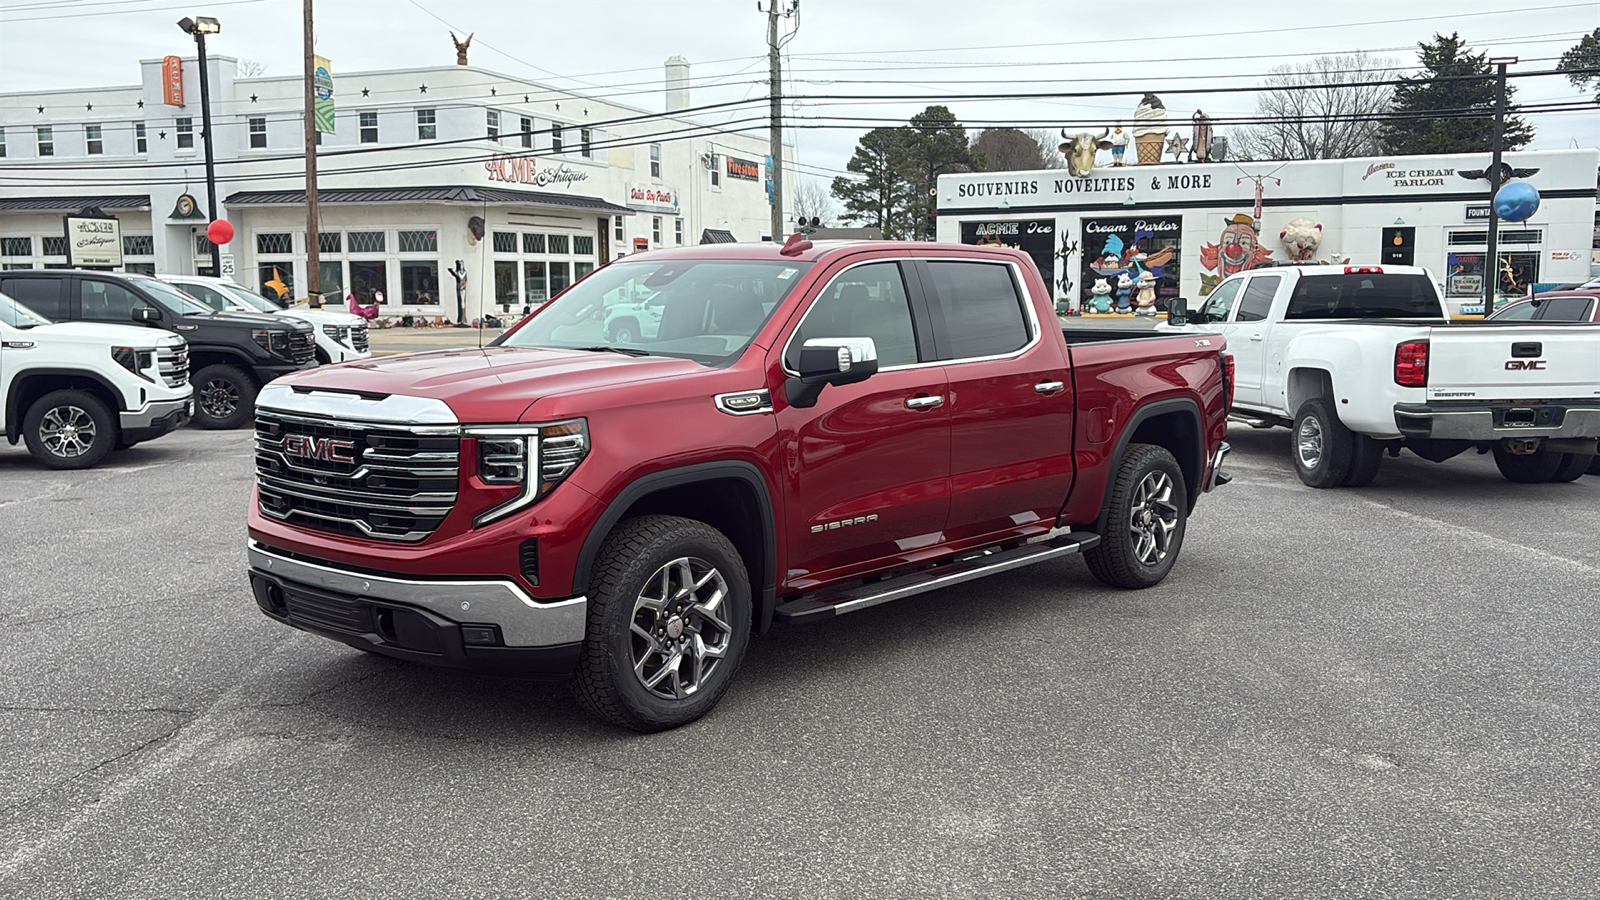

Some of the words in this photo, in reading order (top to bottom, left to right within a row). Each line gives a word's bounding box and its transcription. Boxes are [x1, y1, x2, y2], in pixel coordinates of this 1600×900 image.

[171, 59, 181, 102] ACME
[485, 153, 537, 185] ACME
[1386, 170, 1406, 179] ICE
[1409, 168, 1455, 178] CREAM
[958, 180, 1039, 198] SOUVENIRS
[1053, 177, 1136, 194] NOVELTIES
[1150, 176, 1162, 191] &
[1167, 174, 1212, 190] MORE
[1394, 178, 1444, 188] PARLOR
[1467, 208, 1491, 217] FOUNTA
[975, 222, 1019, 235] ACME
[1026, 221, 1053, 234] Ice
[1086, 220, 1128, 233] Cream
[1134, 219, 1179, 232] Parlor
[222, 264, 234, 273] 25
[1504, 360, 1547, 370] GMC
[284, 433, 355, 464] GMC
[810, 514, 879, 533] SIERRA
